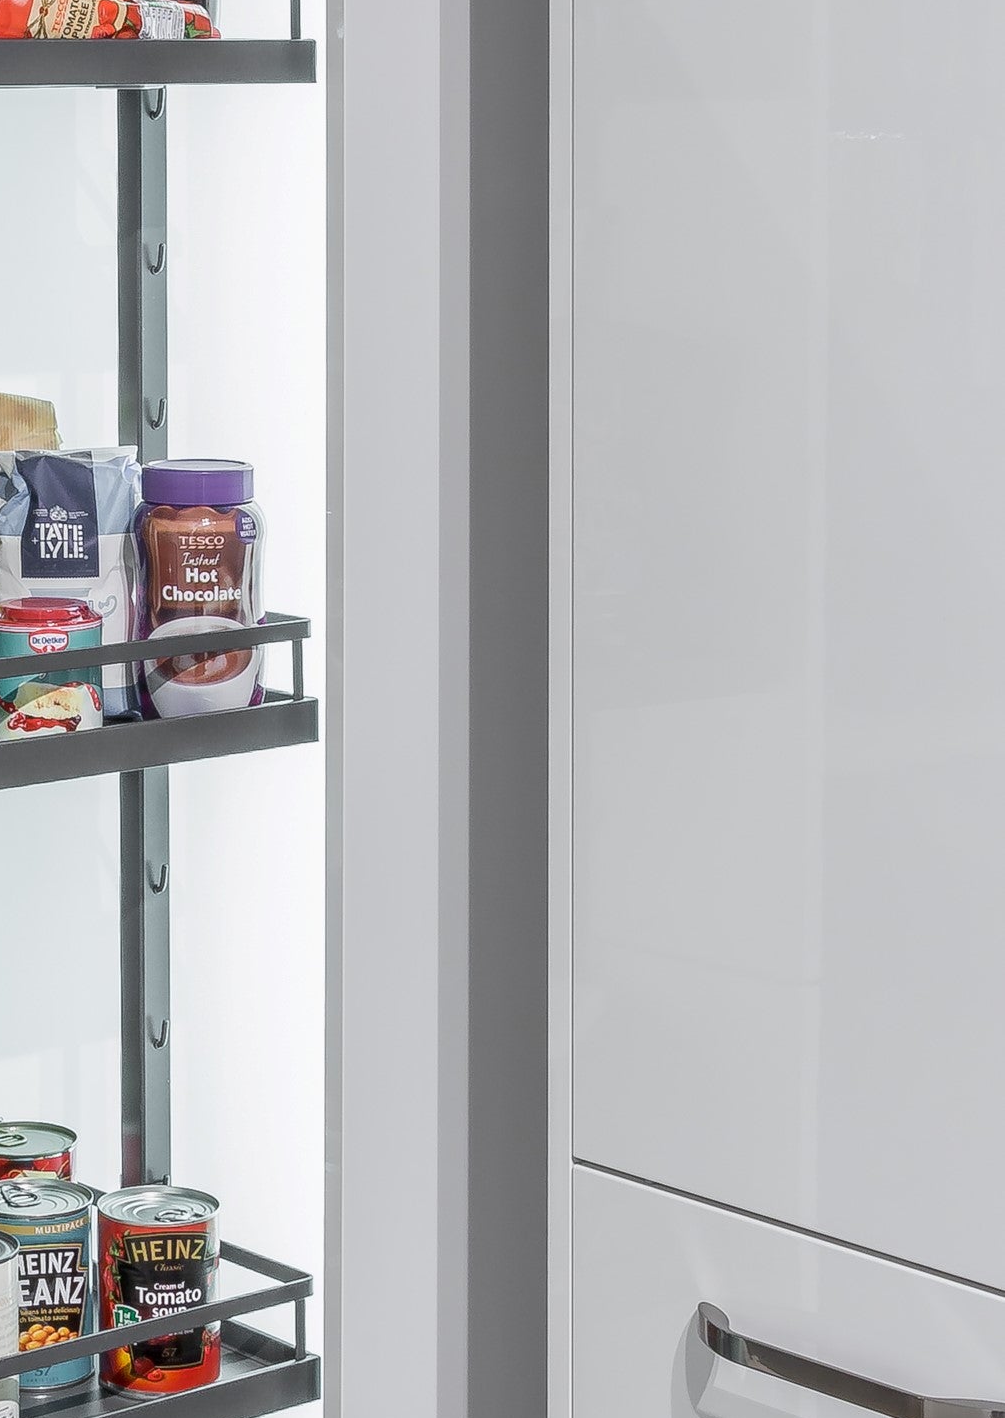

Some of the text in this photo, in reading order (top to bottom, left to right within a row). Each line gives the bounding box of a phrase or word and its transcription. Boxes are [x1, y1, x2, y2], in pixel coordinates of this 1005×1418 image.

[35, 523, 84, 541] TATE
[178, 536, 224, 546] TESCO
[40, 541, 84, 558] LYLE
[181, 552, 220, 566] Instant
[185, 568, 218, 583] Hot
[162, 585, 241, 602] Chocolate
[41, 636, 66, 644] Oetker
[34, 1219, 85, 1235] MULTIPACK
[131, 1239, 205, 1262] HEINZ
[154, 1263, 184, 1271] Classic
[18, 1276, 85, 1307] EANZ
[177, 1281, 185, 1289] of
[135, 1286, 202, 1304] Tomato
